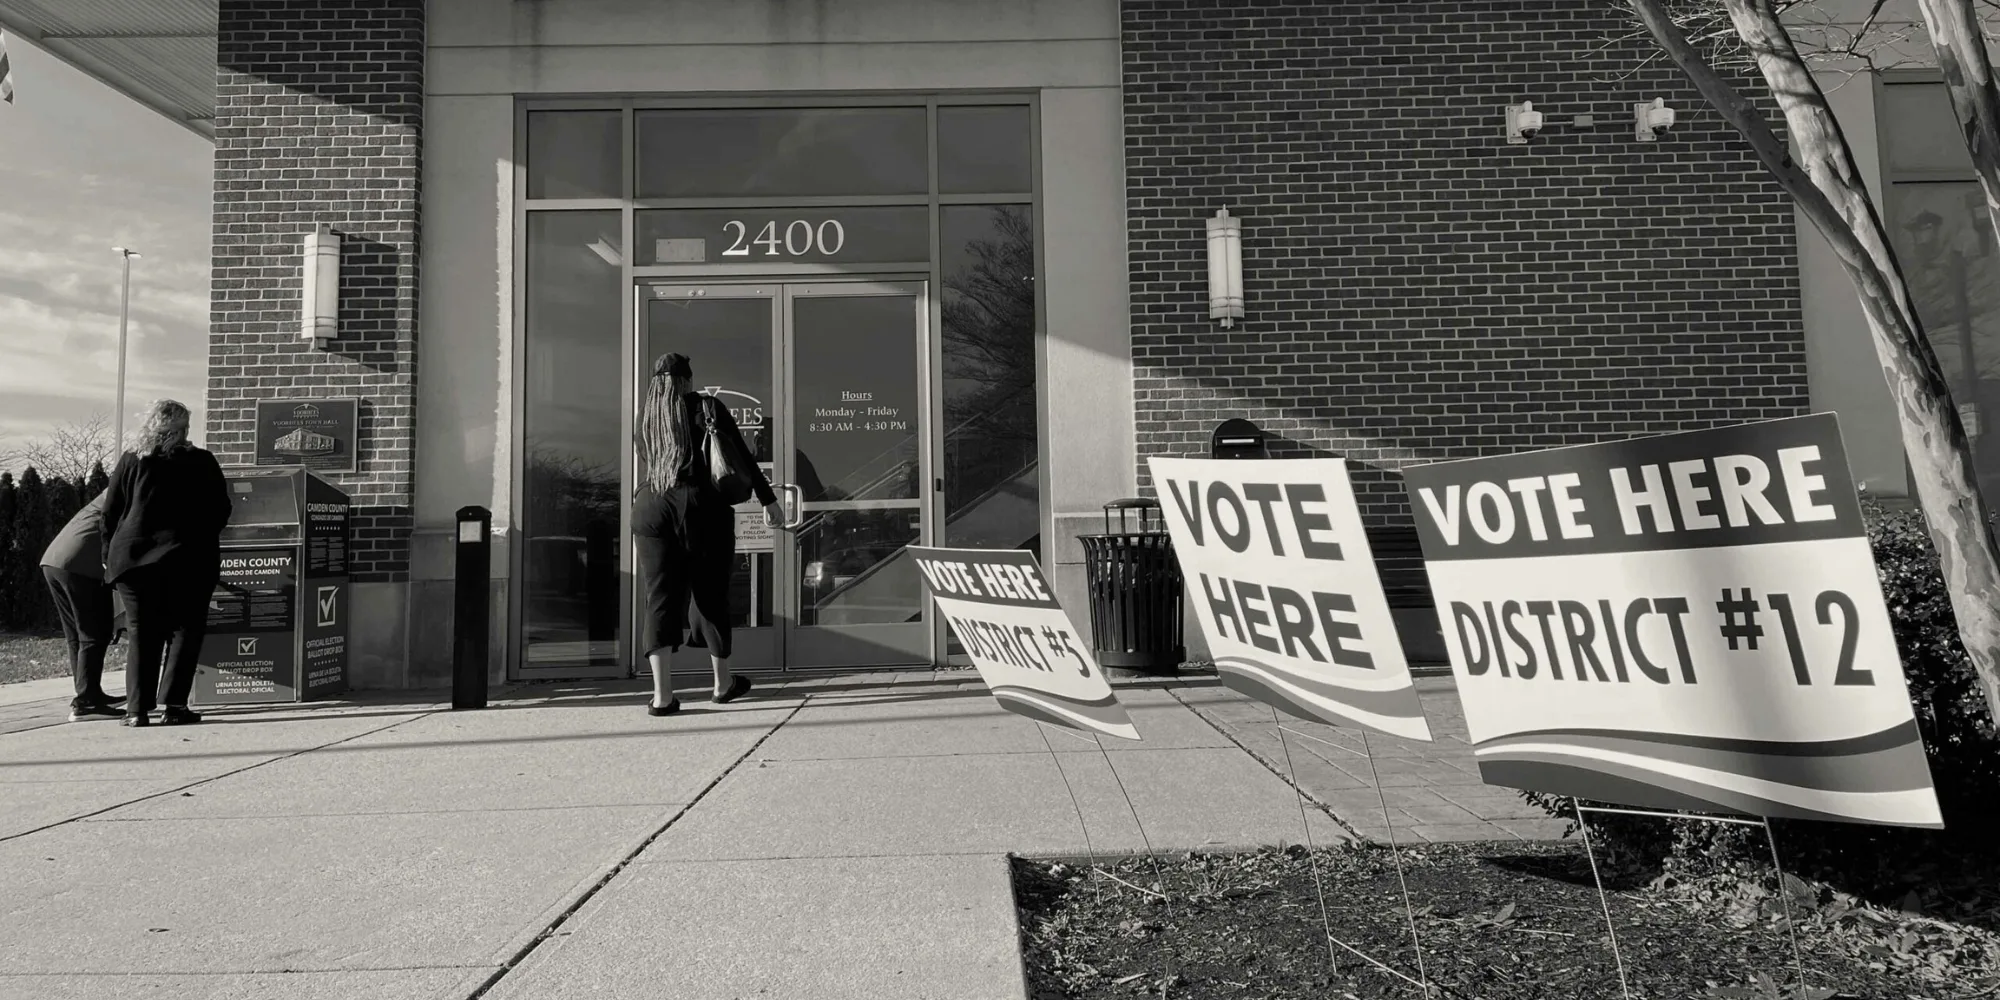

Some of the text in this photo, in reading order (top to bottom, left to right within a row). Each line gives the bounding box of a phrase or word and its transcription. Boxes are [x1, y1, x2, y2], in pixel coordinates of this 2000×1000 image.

[722, 220, 845, 256] 2400
[815, 407, 856, 418] Monday
[867, 406, 899, 417] Friday
[841, 391, 872, 401] Hours
[809, 422, 833, 432] 8:30
[835, 422, 853, 431] AM
[864, 422, 887, 430] 4:30
[890, 421, 906, 430] PM
[307, 503, 348, 512] CAMDEN COUNTY
[1418, 445, 1837, 546] VOTE HERE
[1166, 478, 1345, 561] VOTE
[249, 557, 291, 567] COUNTY
[915, 558, 1051, 601] VOTE HERE
[1200, 572, 1376, 670] HERE
[1450, 587, 1876, 686] DISTRICT #12
[952, 616, 1090, 678] DISTRICT #5
